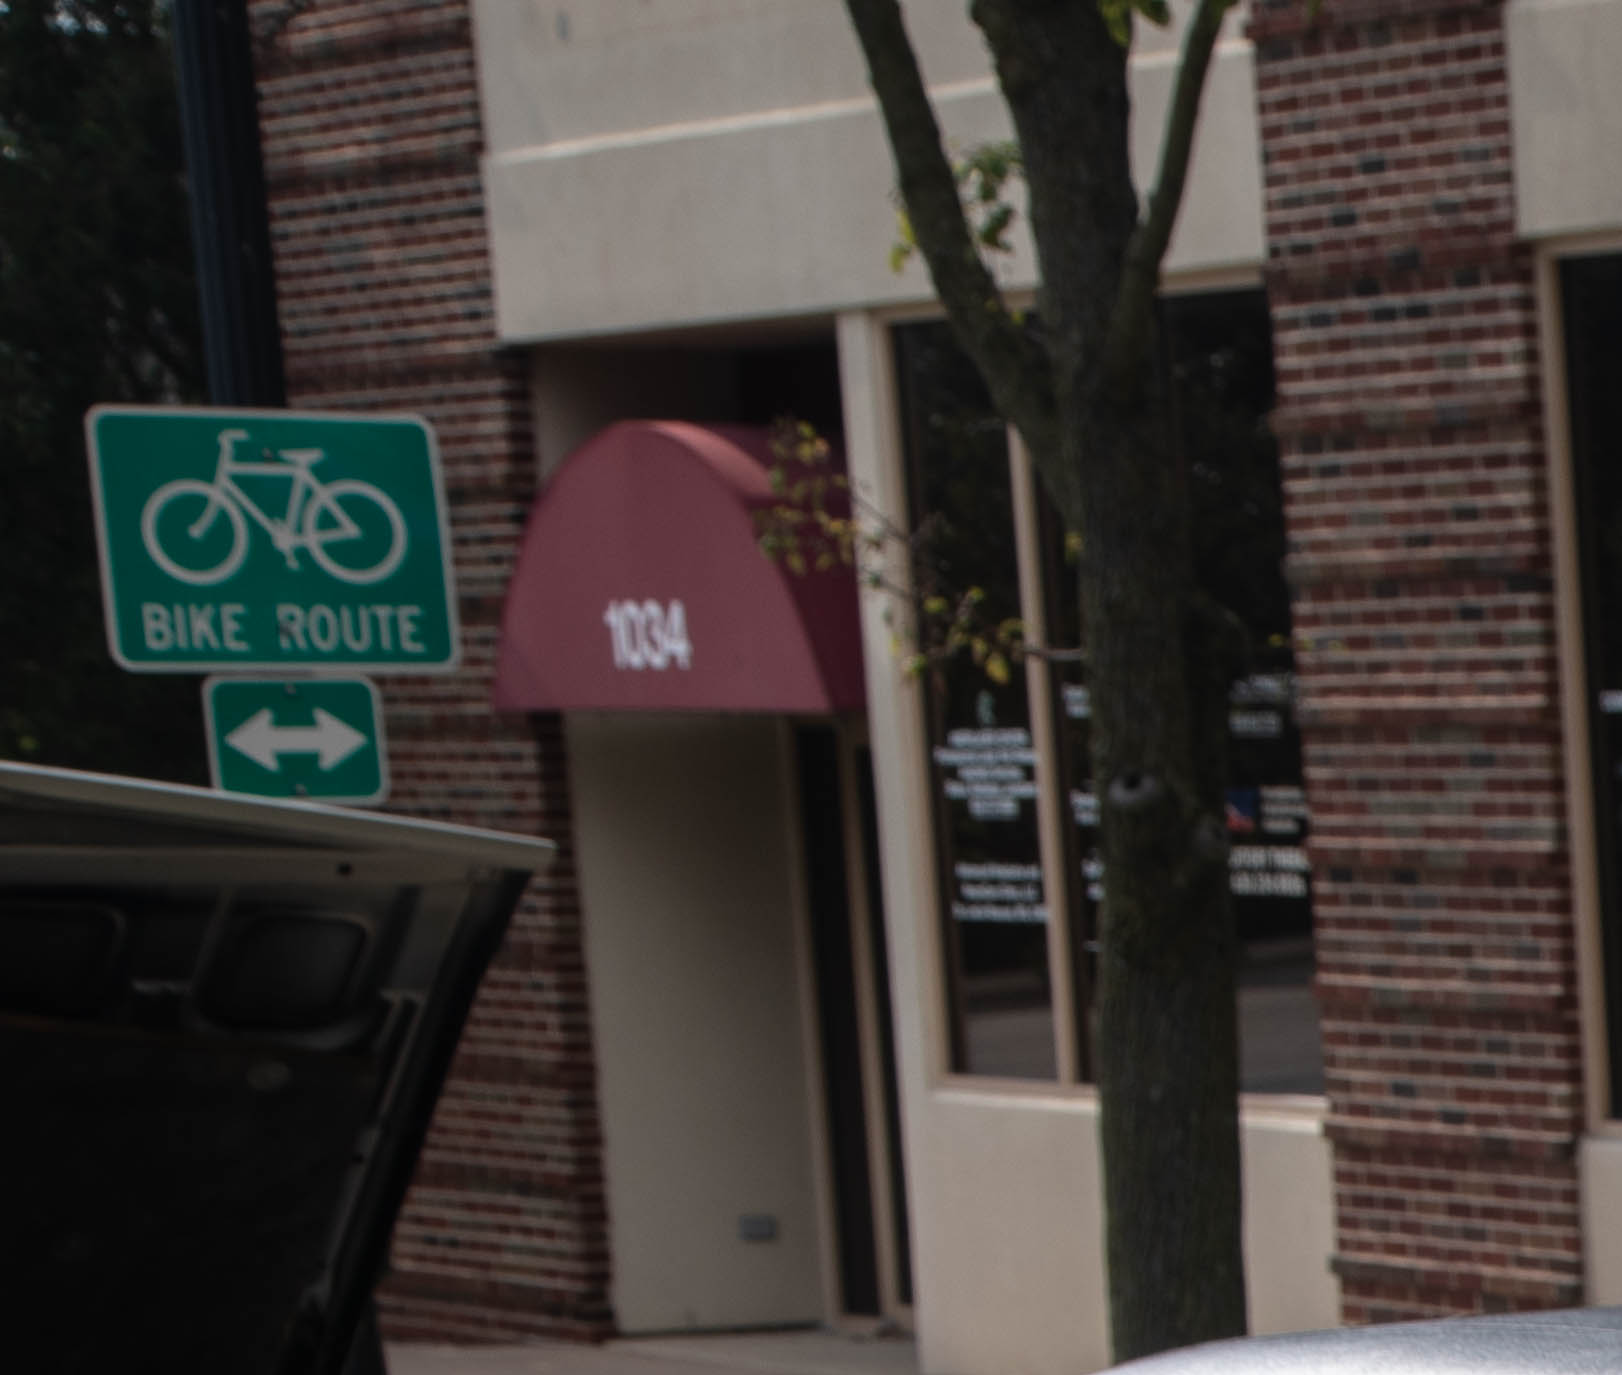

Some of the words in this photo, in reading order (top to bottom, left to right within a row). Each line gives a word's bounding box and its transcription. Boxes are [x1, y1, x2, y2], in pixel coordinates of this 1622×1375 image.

[142, 603, 250, 654] BIKE
[278, 604, 426, 654] ROUTE
[604, 598, 693, 671] 1034
